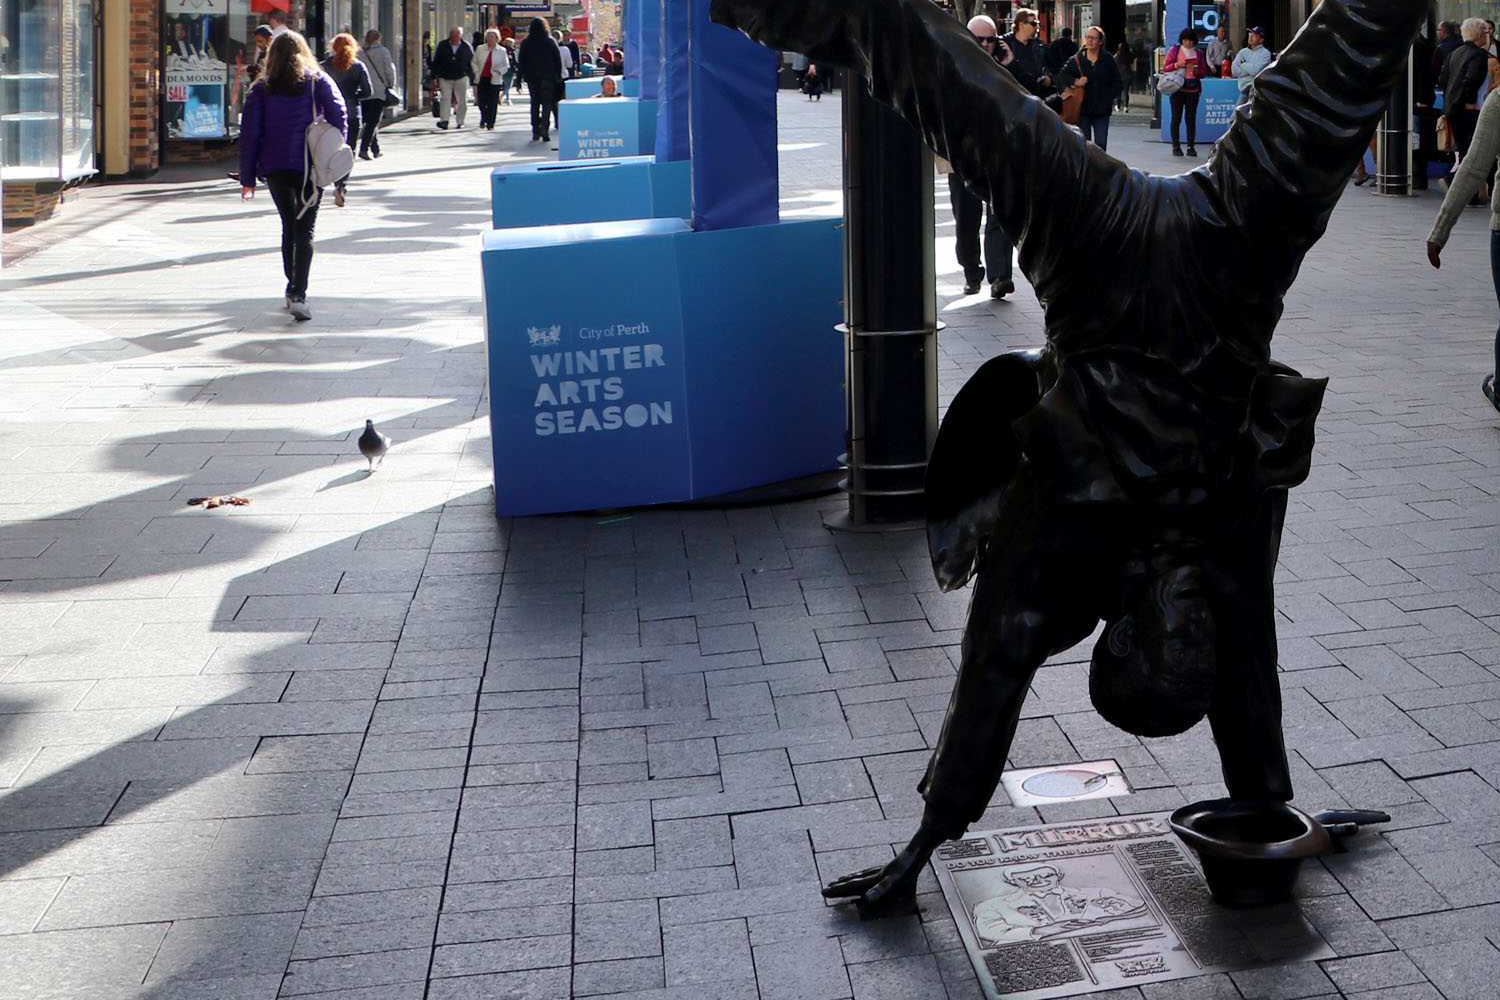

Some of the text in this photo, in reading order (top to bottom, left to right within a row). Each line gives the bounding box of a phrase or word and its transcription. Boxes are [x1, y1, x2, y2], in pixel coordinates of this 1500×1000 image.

[167, 74, 223, 83] DIAMONDS
[169, 86, 187, 100] SALE
[577, 138, 624, 149] WINTER
[577, 149, 609, 158] ARTS
[579, 322, 650, 341] City of Perth
[530, 344, 665, 377] WINTER
[534, 377, 624, 407] ARTS
[535, 401, 673, 436] SEASON
